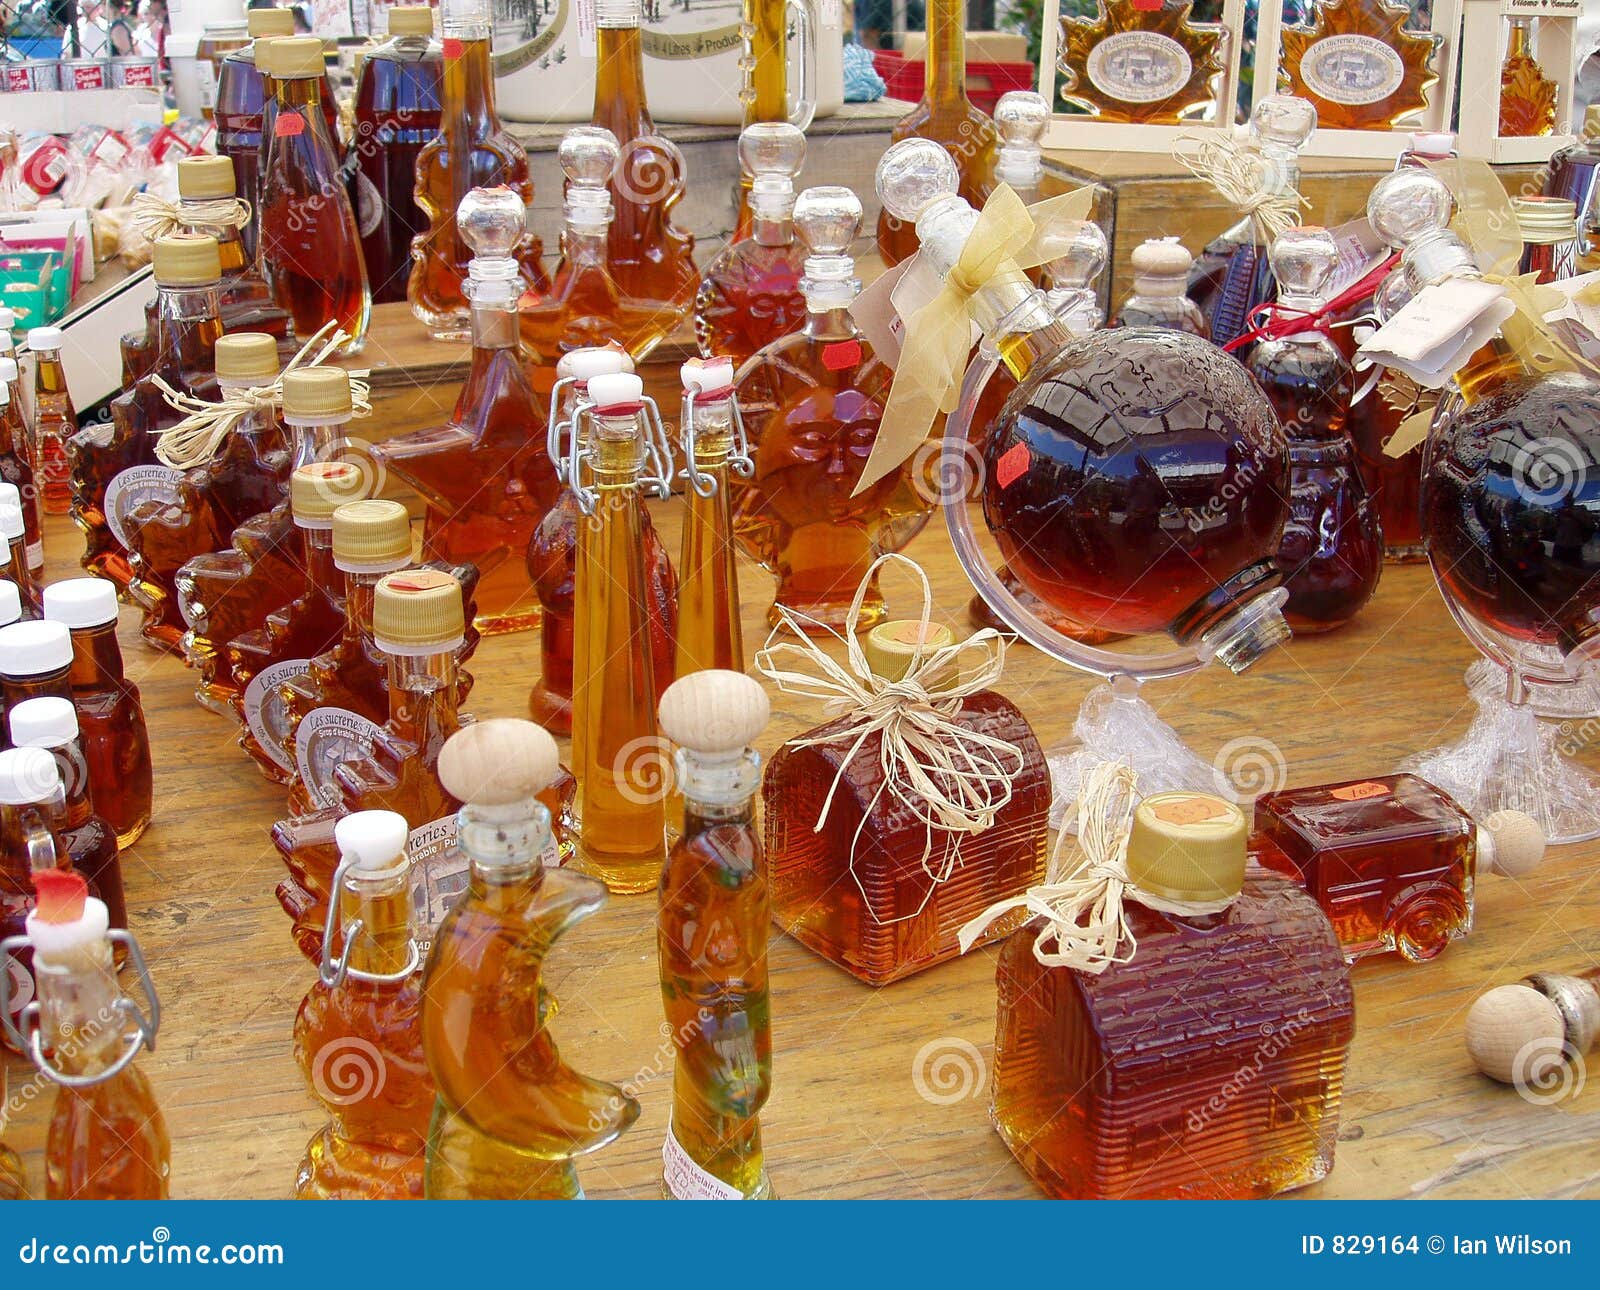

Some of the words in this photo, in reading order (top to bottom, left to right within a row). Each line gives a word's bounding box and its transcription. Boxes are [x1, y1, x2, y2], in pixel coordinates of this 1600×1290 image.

[705, 33, 741, 52] Produc
[260, 671, 278, 691] Les
[279, 664, 309, 679] sucrer
[311, 716, 324, 731] Les
[325, 714, 364, 732] sucreries
[409, 825, 447, 851] reries
